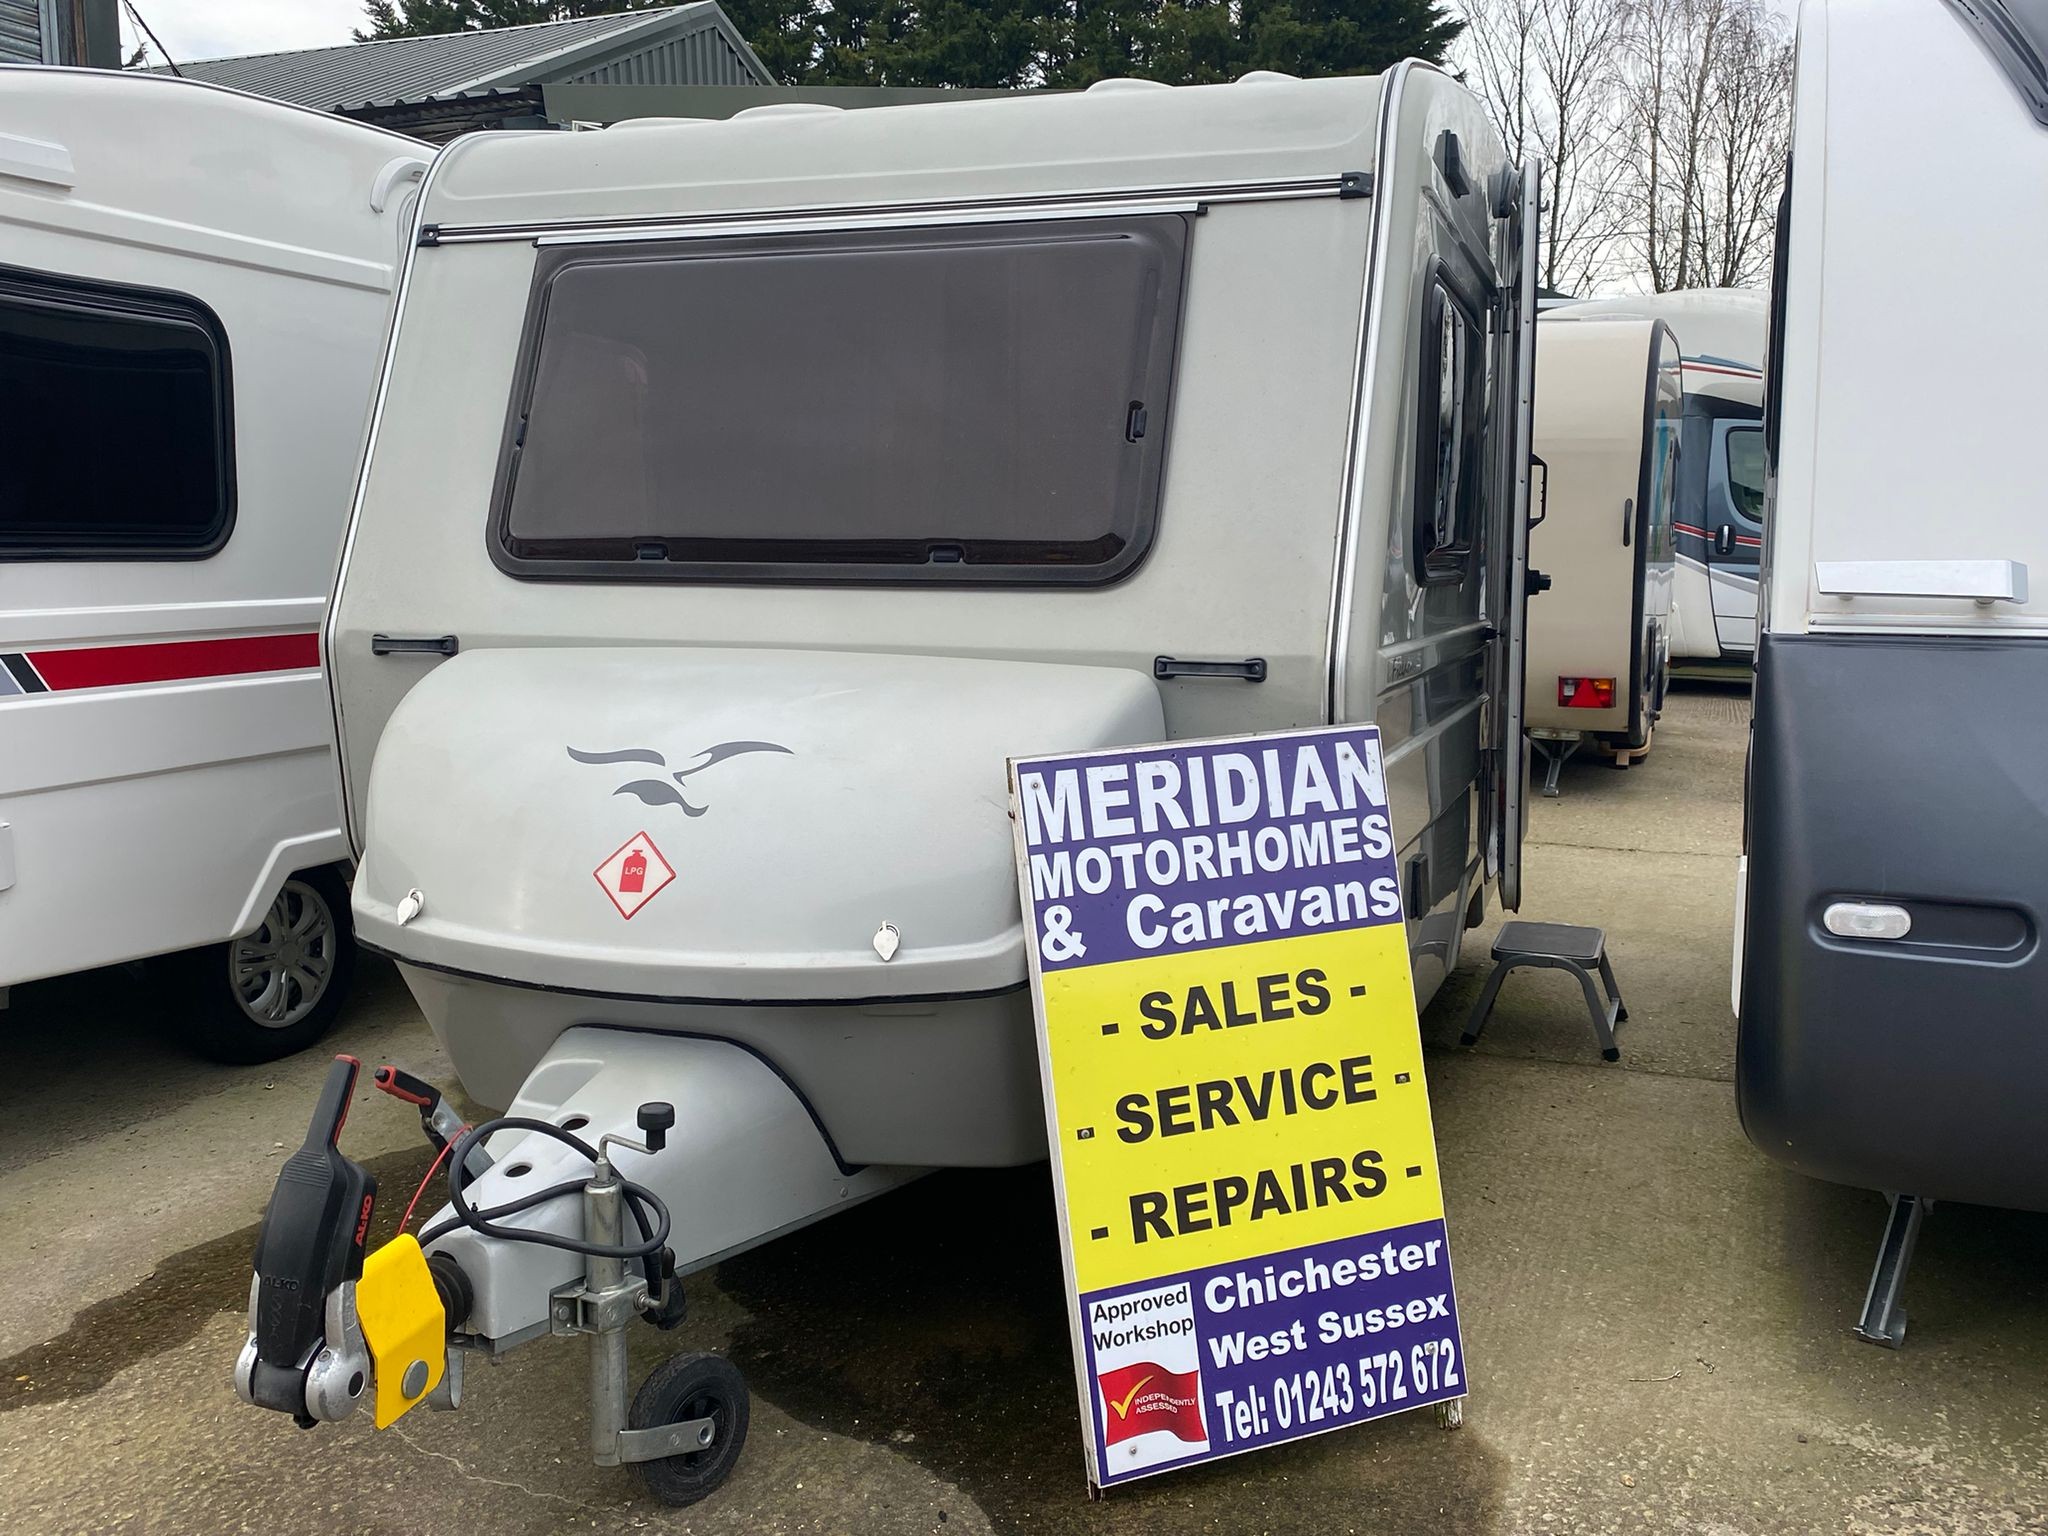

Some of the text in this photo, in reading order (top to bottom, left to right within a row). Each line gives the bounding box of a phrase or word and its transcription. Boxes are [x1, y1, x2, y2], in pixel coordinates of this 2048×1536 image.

[1020, 739, 1387, 845] MERIDIAN
[624, 867, 644, 875] LPG
[1029, 814, 1392, 900] MOTORHOMES
[1041, 877, 1399, 961] & Caravans
[1139, 968, 1331, 1039] SALES
[1115, 1055, 1377, 1143] SERVICE
[1129, 1150, 1387, 1244] REPAIRS
[1093, 1286, 1188, 1323] Approved
[1204, 1239, 1441, 1313] Chichester
[1093, 1317, 1193, 1351] Workshop
[1208, 1293, 1450, 1369] West Sussex
[1135, 1393, 1196, 1406] INDEPENDENTLY
[1136, 1402, 1178, 1414] ASSESSED
[1215, 1338, 1459, 1442] Tel: 01243 572 672
